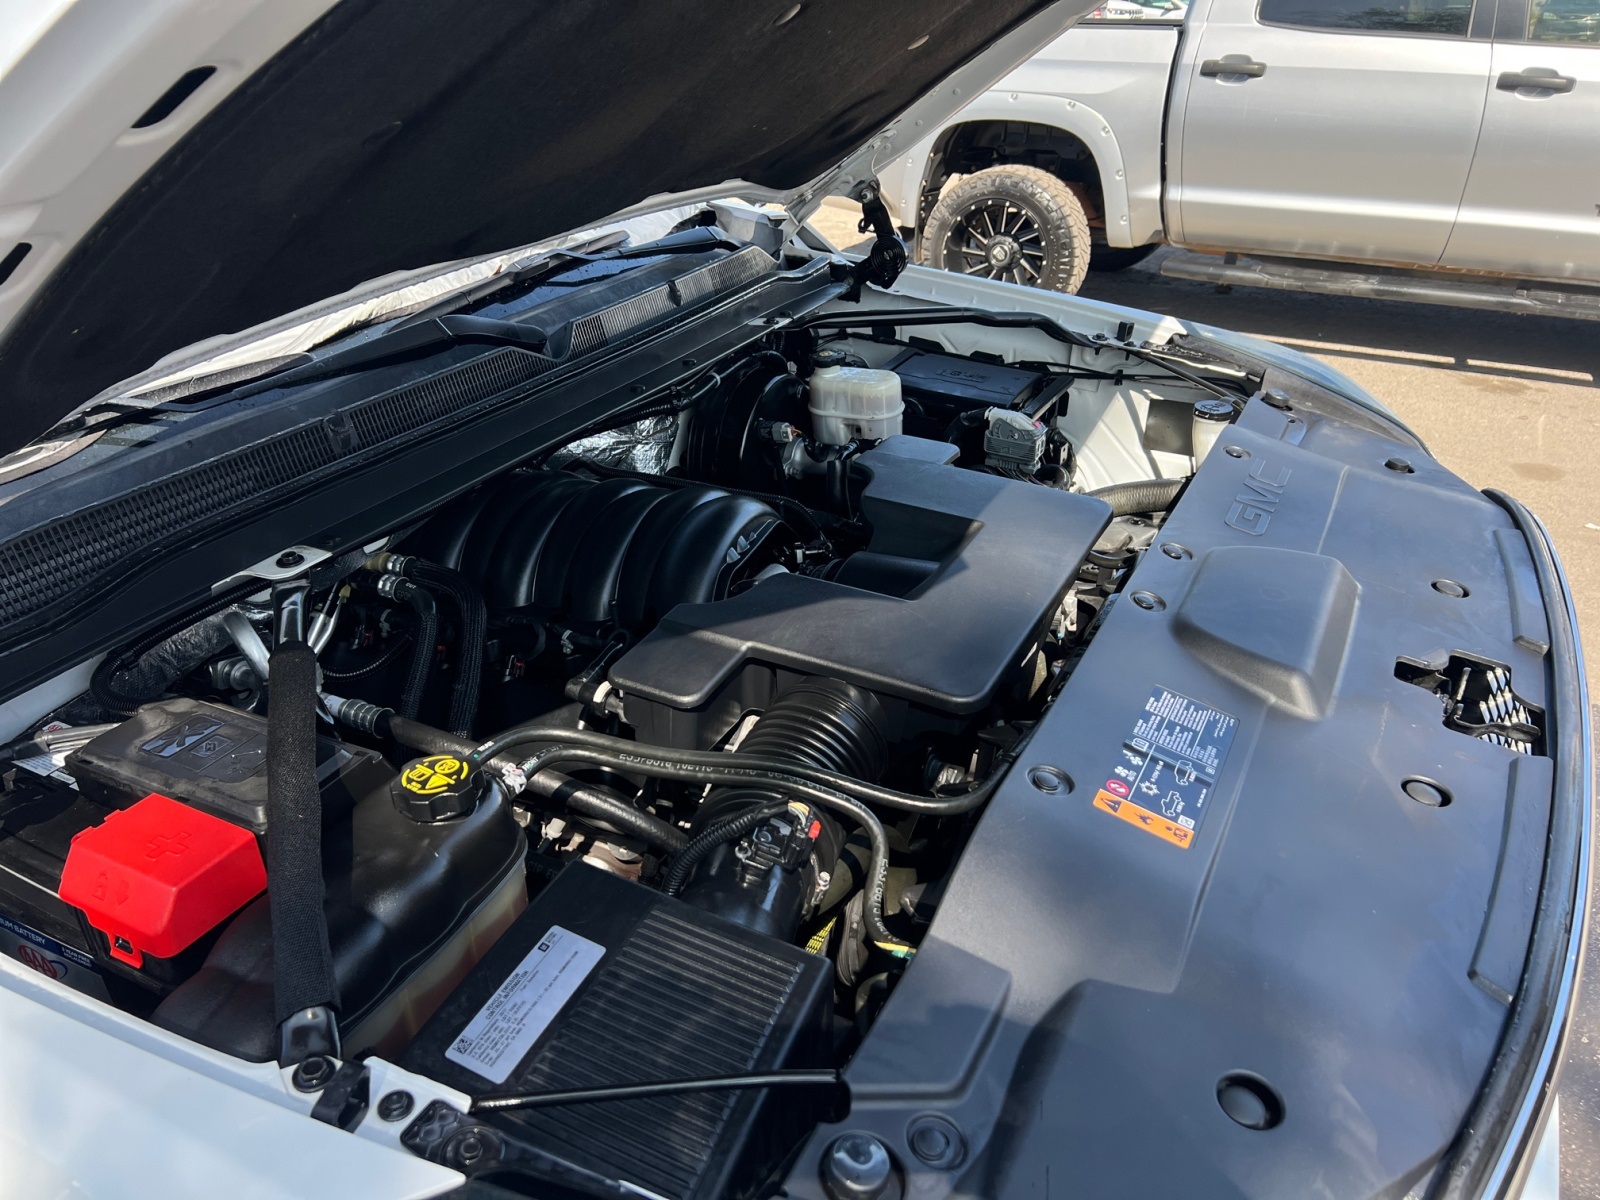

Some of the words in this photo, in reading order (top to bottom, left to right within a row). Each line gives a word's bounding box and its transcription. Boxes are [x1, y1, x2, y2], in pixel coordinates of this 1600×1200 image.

[1224, 458, 1292, 536] GMC
[14, 924, 46, 945] BATTERY
[485, 1000, 505, 1020] CONTROL
[503, 970, 529, 999] INFORMATION
[486, 993, 503, 1011] VEHICLE
[500, 972, 520, 993] EMISSION
